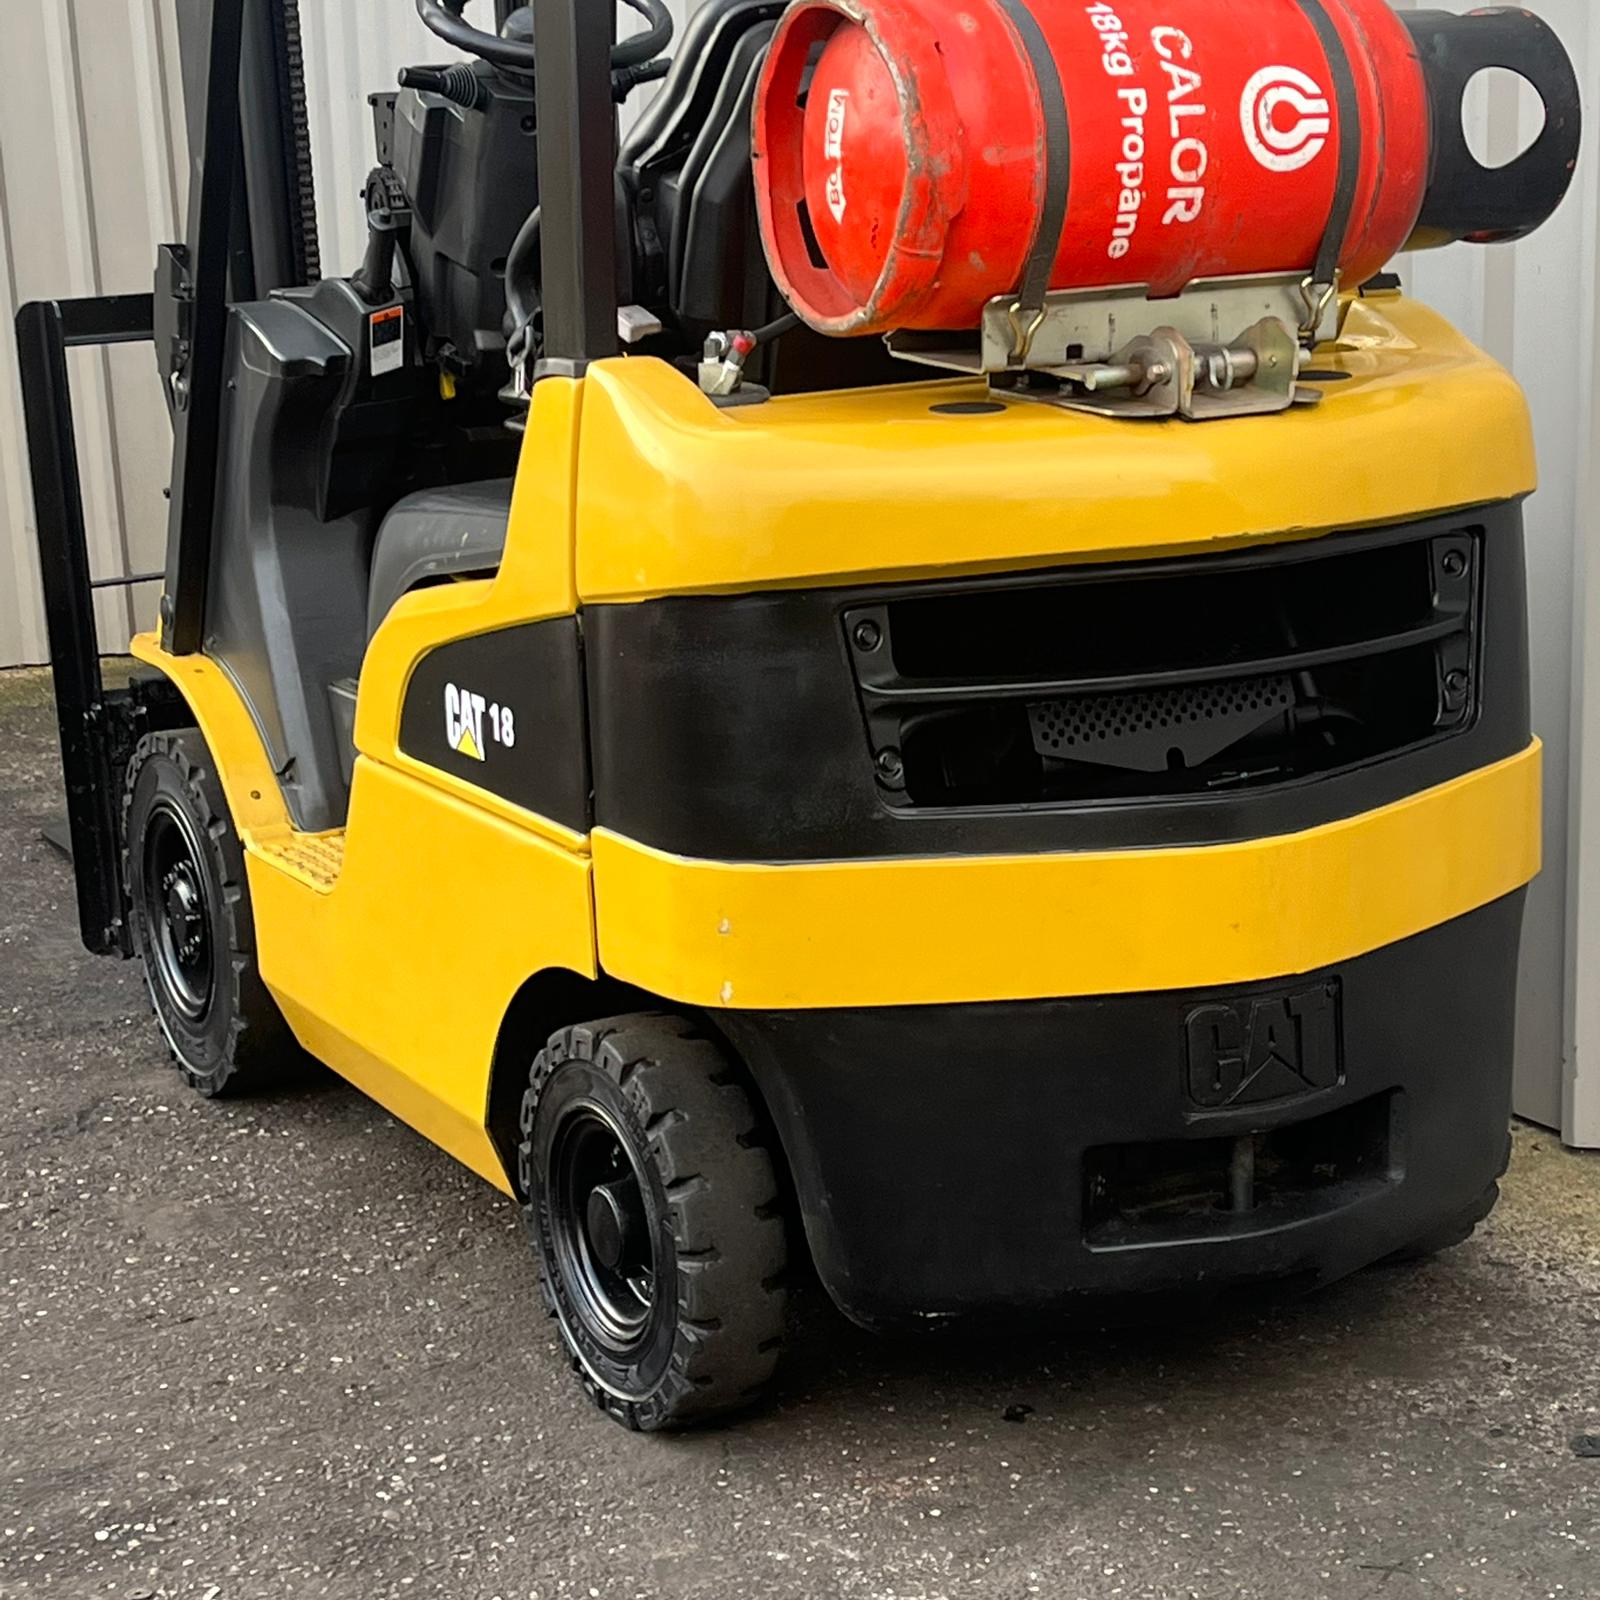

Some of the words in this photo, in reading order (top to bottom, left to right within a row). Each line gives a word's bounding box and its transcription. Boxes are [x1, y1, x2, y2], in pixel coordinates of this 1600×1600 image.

[1085, 1, 1135, 76] 18kg
[828, 93, 844, 205] BOTOM
[1107, 88, 1148, 259] Propane
[1151, 26, 1207, 224] CALOR
[445, 682, 486, 761] CAT
[488, 702, 515, 747] 18
[1185, 984, 1342, 1107] CAT
